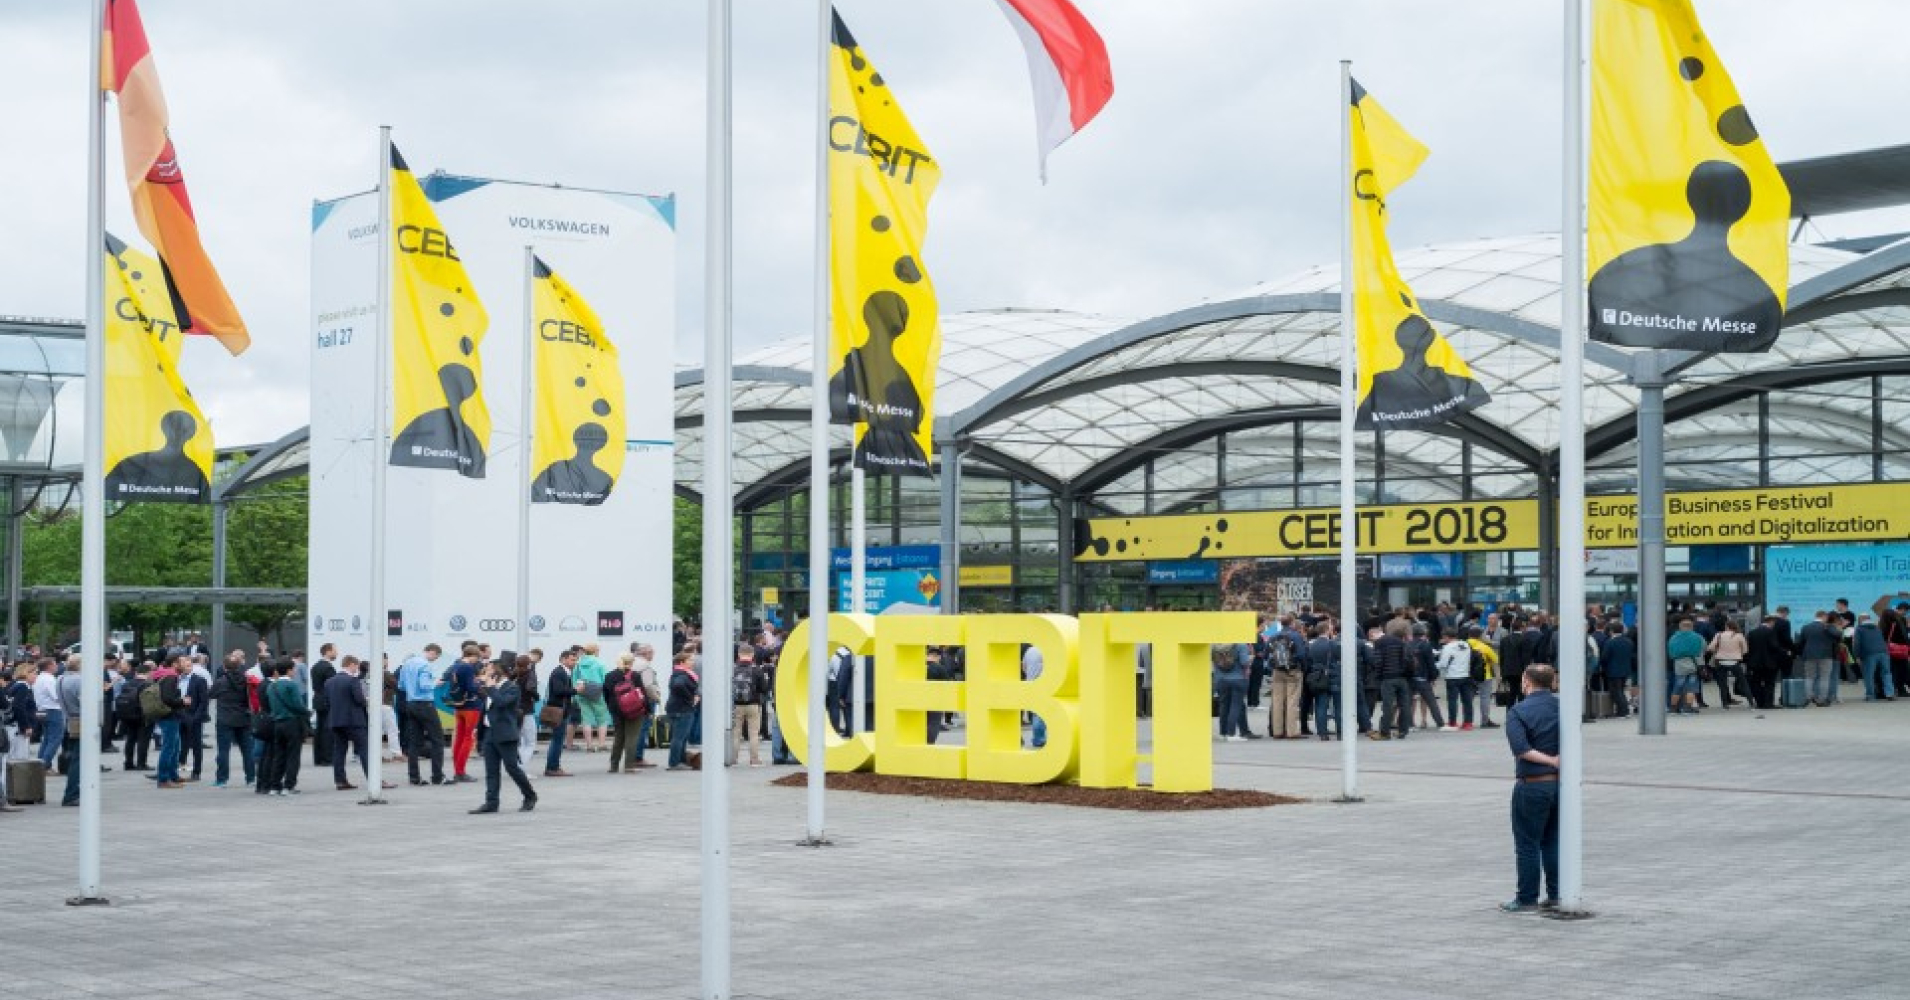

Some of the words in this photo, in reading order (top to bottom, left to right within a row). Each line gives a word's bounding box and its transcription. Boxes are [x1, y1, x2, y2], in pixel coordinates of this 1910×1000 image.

[508, 215, 610, 236] VOLKSWAGEN
[1619, 310, 1698, 332] Deutsche
[1702, 316, 1757, 334] Messe
[317, 328, 338, 348] hall
[339, 326, 353, 345] 27
[1588, 500, 1638, 520] Europ
[1668, 495, 1753, 515] Business
[1756, 491, 1833, 511] Festival
[1406, 505, 1507, 546] 2018
[1588, 524, 1613, 541] for
[1718, 519, 1756, 538] and
[1759, 515, 1889, 540] Digitalization
[1776, 557, 1856, 574] Welcome
[1860, 555, 1879, 573] all
[1278, 582, 1314, 600] CLOSER
[632, 622, 668, 632] MOIA
[775, 611, 1257, 793] CEBIT
